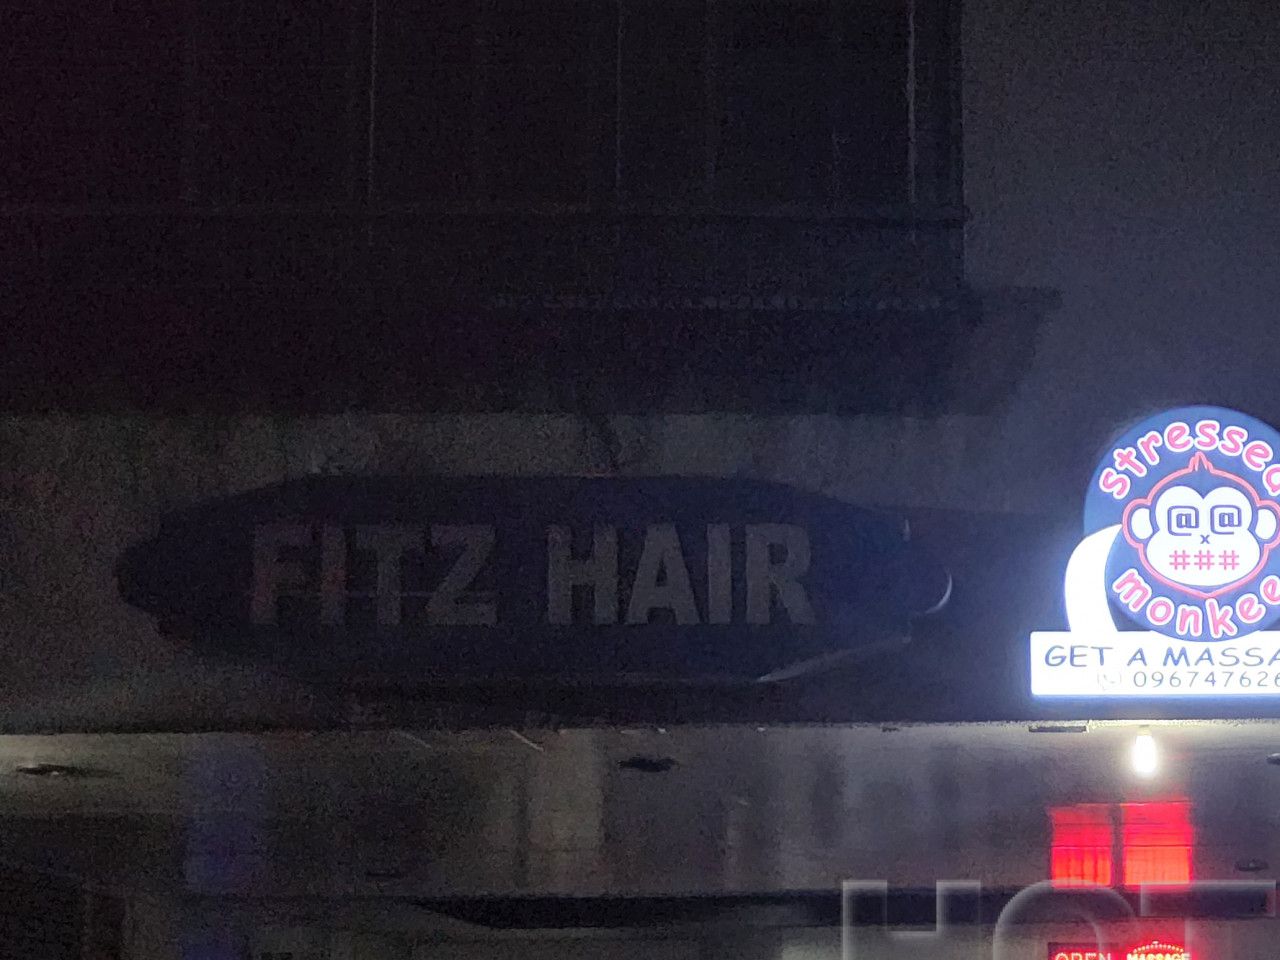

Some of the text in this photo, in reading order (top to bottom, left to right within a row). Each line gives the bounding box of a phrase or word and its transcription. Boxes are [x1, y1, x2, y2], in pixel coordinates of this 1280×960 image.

[250, 522, 815, 627] FITZ HAIR
[1044, 645, 1115, 668] GET
[1127, 646, 1147, 667] A
